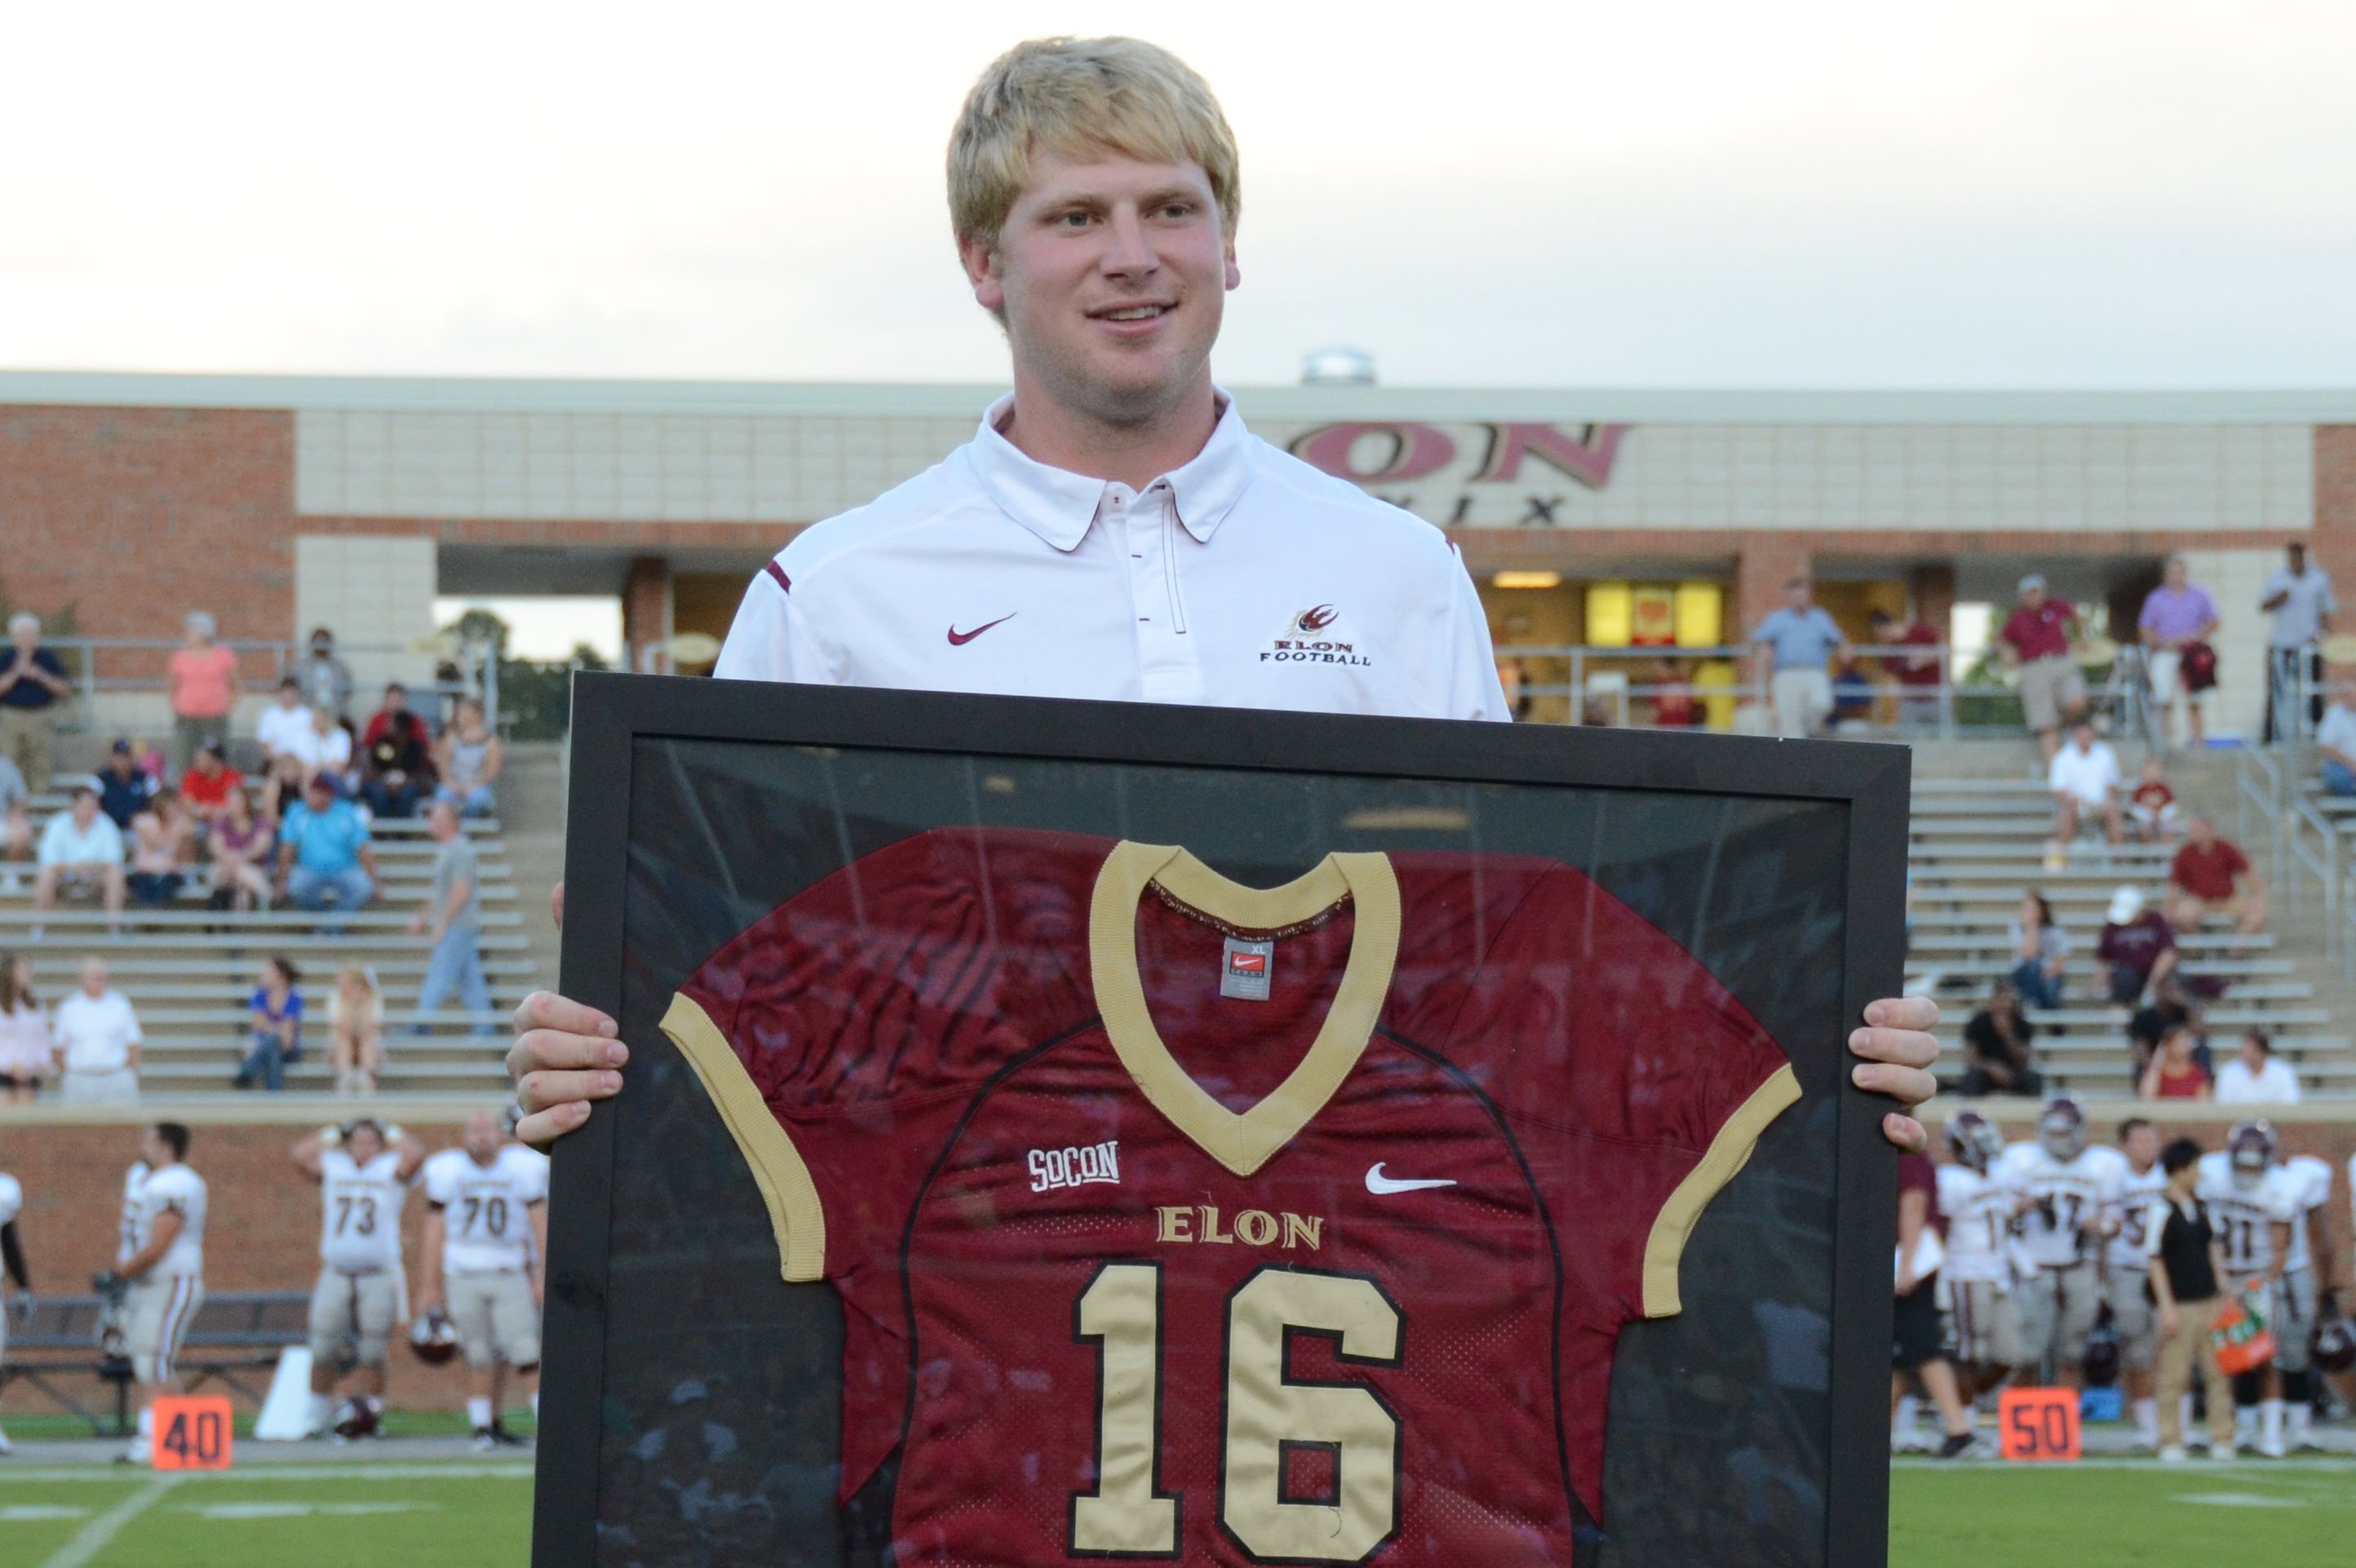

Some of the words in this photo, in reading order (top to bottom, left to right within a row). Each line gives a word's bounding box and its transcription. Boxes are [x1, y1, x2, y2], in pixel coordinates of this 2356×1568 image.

[1260, 652, 1371, 667] FOOTBALL
[1274, 640, 1353, 653] ELON
[1251, 945, 1266, 955] XL
[1028, 1141, 1120, 1192] SOCON
[337, 1196, 376, 1238] 73
[463, 1197, 507, 1236] 70
[1155, 1204, 1324, 1250] ELON
[1066, 1259, 1407, 1566] 16
[2013, 1403, 2069, 1454] 50
[163, 1411, 219, 1463] 40
